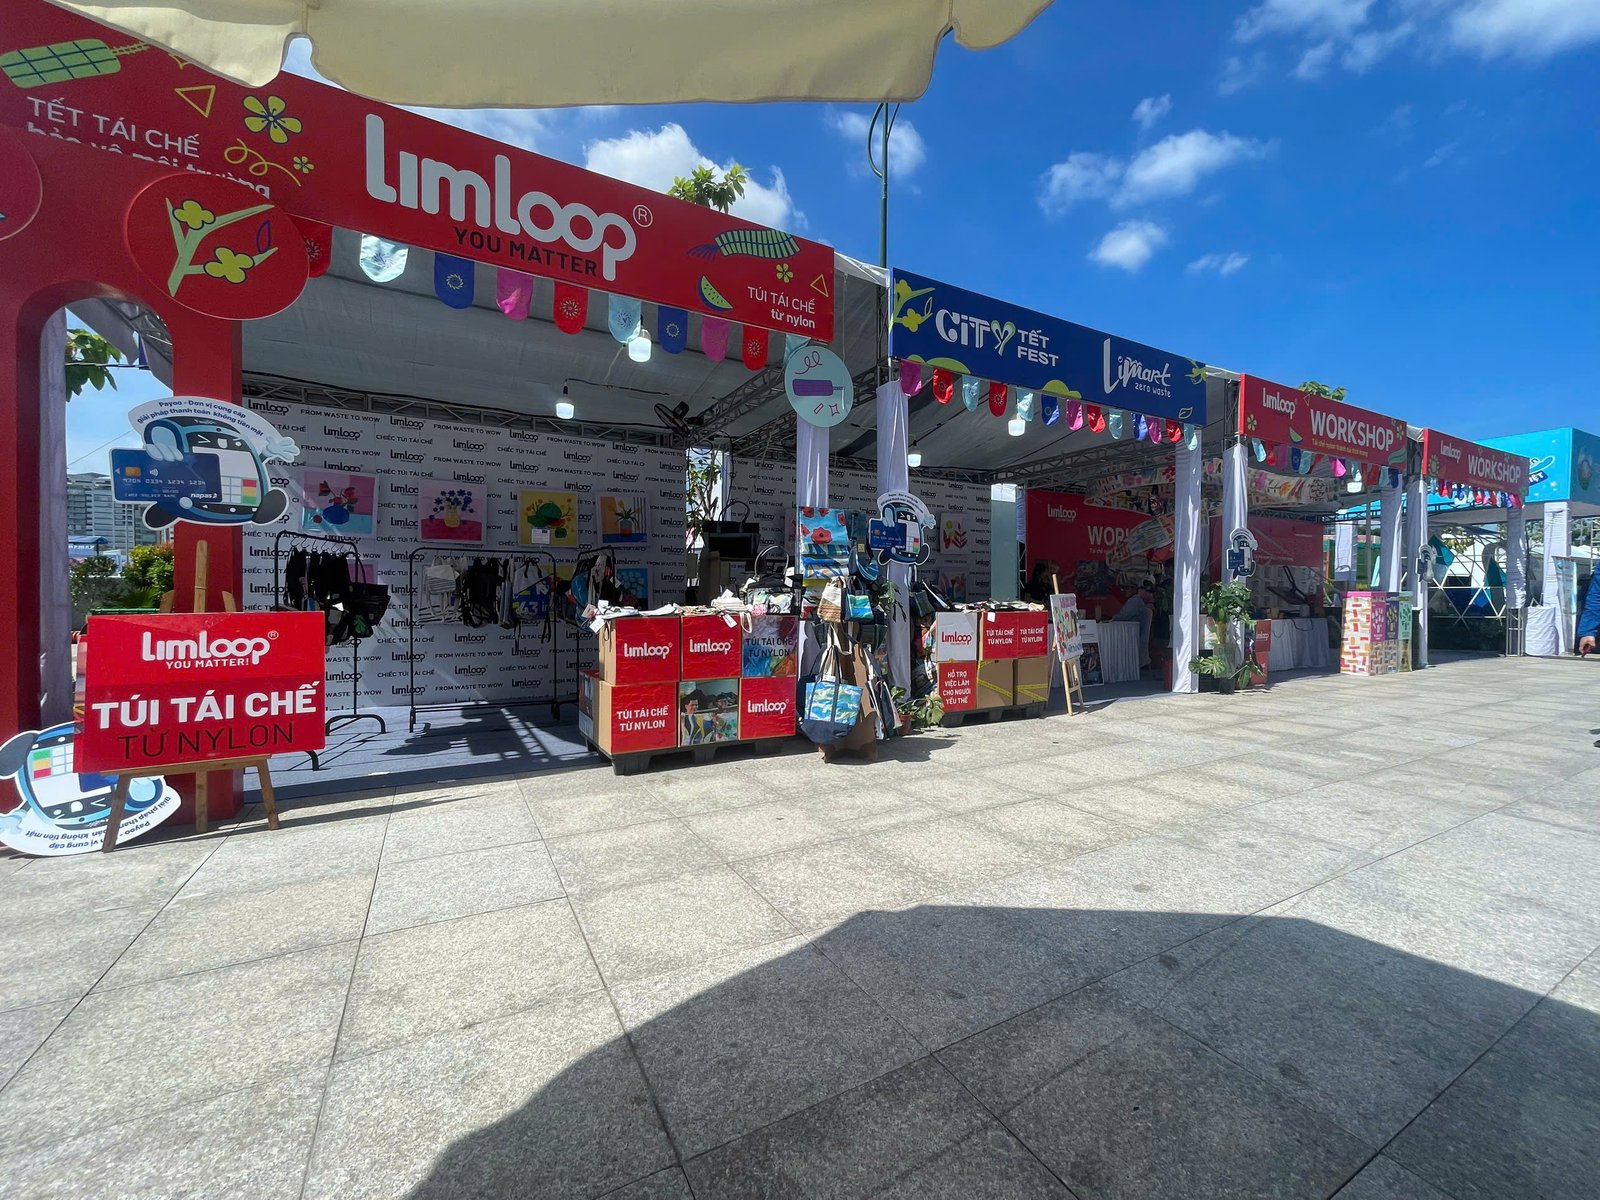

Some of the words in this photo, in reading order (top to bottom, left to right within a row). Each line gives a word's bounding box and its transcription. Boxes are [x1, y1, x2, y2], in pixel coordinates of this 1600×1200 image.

[27, 97, 84, 127] TẾT
[93, 111, 137, 142] TÁI
[145, 129, 200, 158] CHẾ
[453, 226, 501, 253] YOU
[509, 240, 598, 277] MATTER
[747, 286, 768, 301] TÚI
[770, 291, 789, 307] TÁI
[792, 297, 815, 314] CHẾ
[771, 308, 784, 321] từ
[786, 313, 815, 329] nylon
[1017, 329, 1049, 349] TẾT
[1017, 345, 1059, 367] FEST
[1134, 381, 1150, 393] zero
[1152, 387, 1171, 398] waste
[300, 408, 322, 416] FROM
[324, 412, 349, 420] WASTE
[453, 425, 475, 433] WASTE
[1310, 408, 1394, 451] WORKSHOP
[301, 444, 322, 452] FROM
[1467, 454, 1522, 484] WORKSHOP
[994, 637, 1012, 645] NYLON
[762, 648, 790, 657] NYLON
[166, 659, 192, 670] YOU
[195, 658, 249, 668] MATTER!
[92, 694, 159, 729] TÚI
[171, 689, 234, 723] TÁI
[244, 680, 320, 718] CHẾ
[617, 707, 633, 720] TÚI
[634, 706, 649, 719] TÁI
[650, 705, 669, 717] CHẾ
[620, 719, 634, 732] TỪ
[634, 719, 665, 730] NYLON
[118, 727, 169, 760] TỪ
[178, 722, 293, 754] NYLON
